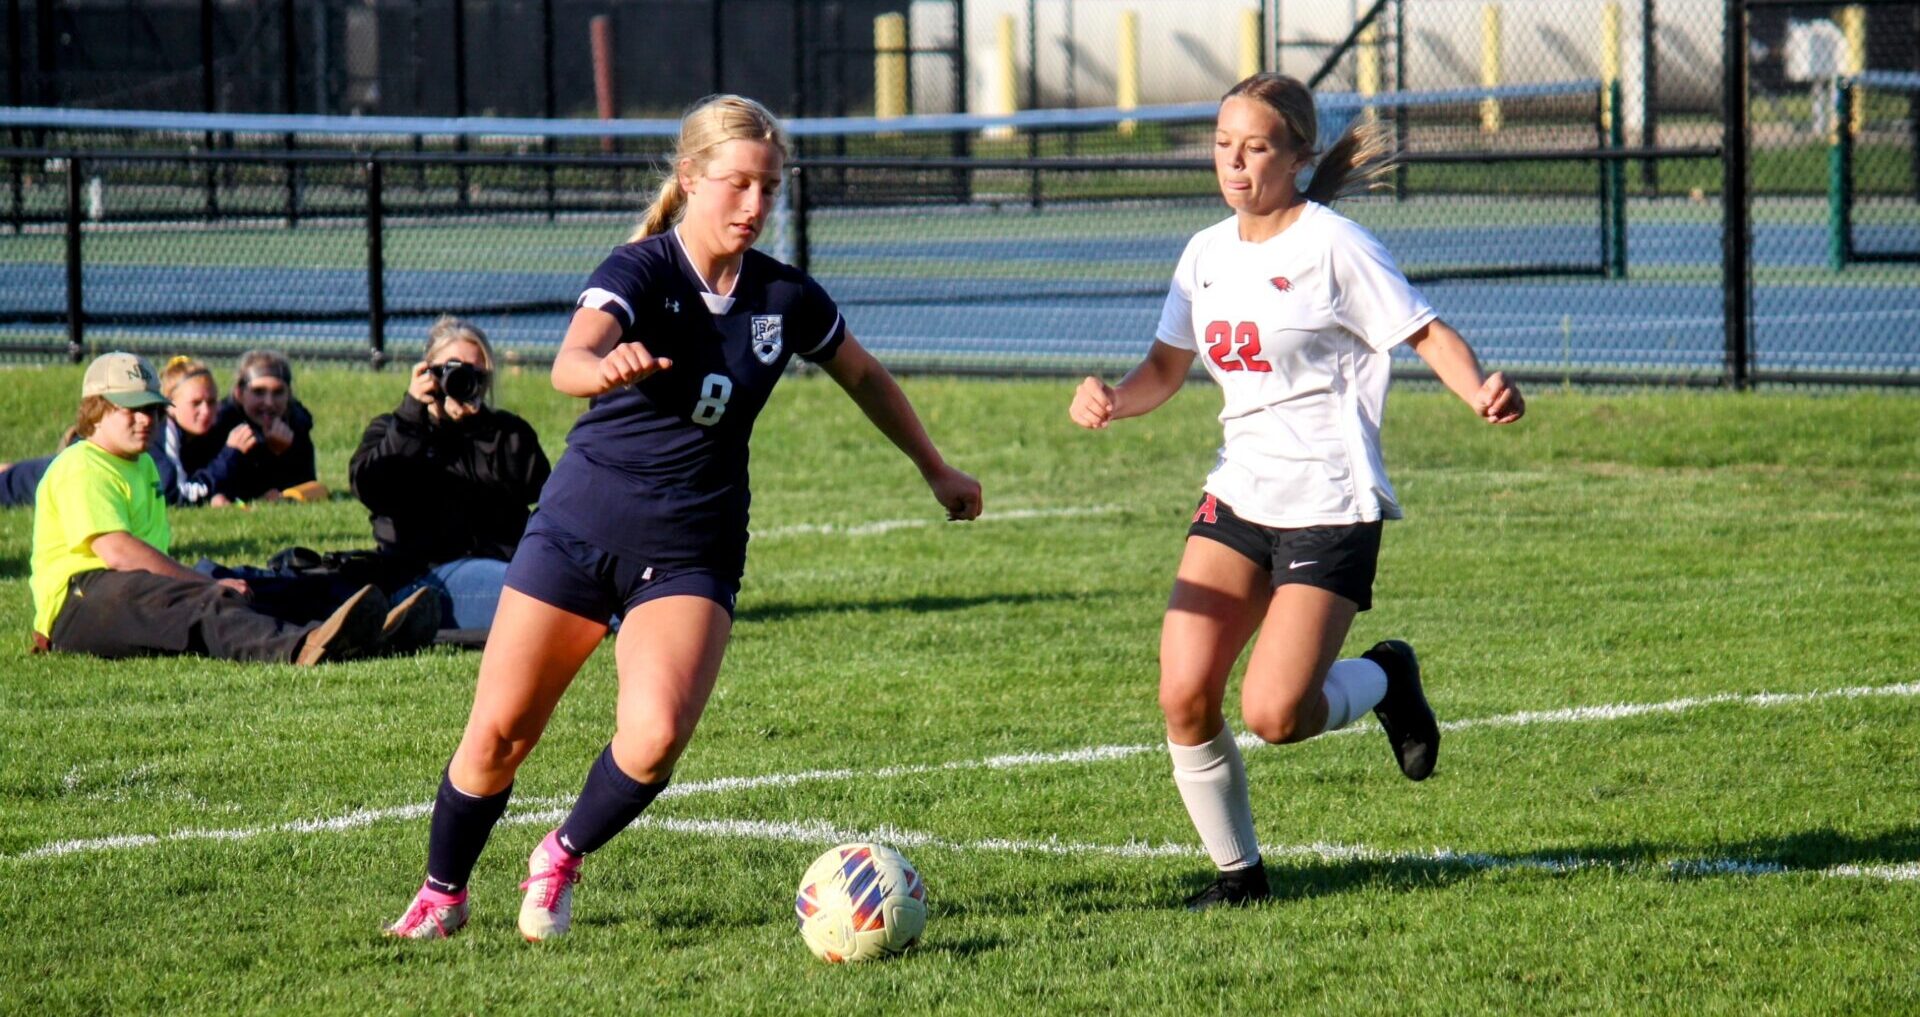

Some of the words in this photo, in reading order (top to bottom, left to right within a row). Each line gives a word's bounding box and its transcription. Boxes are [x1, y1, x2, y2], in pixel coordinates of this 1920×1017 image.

[1205, 320, 1273, 372] 22
[691, 373, 733, 426] 8
[1192, 493, 1218, 524] A
